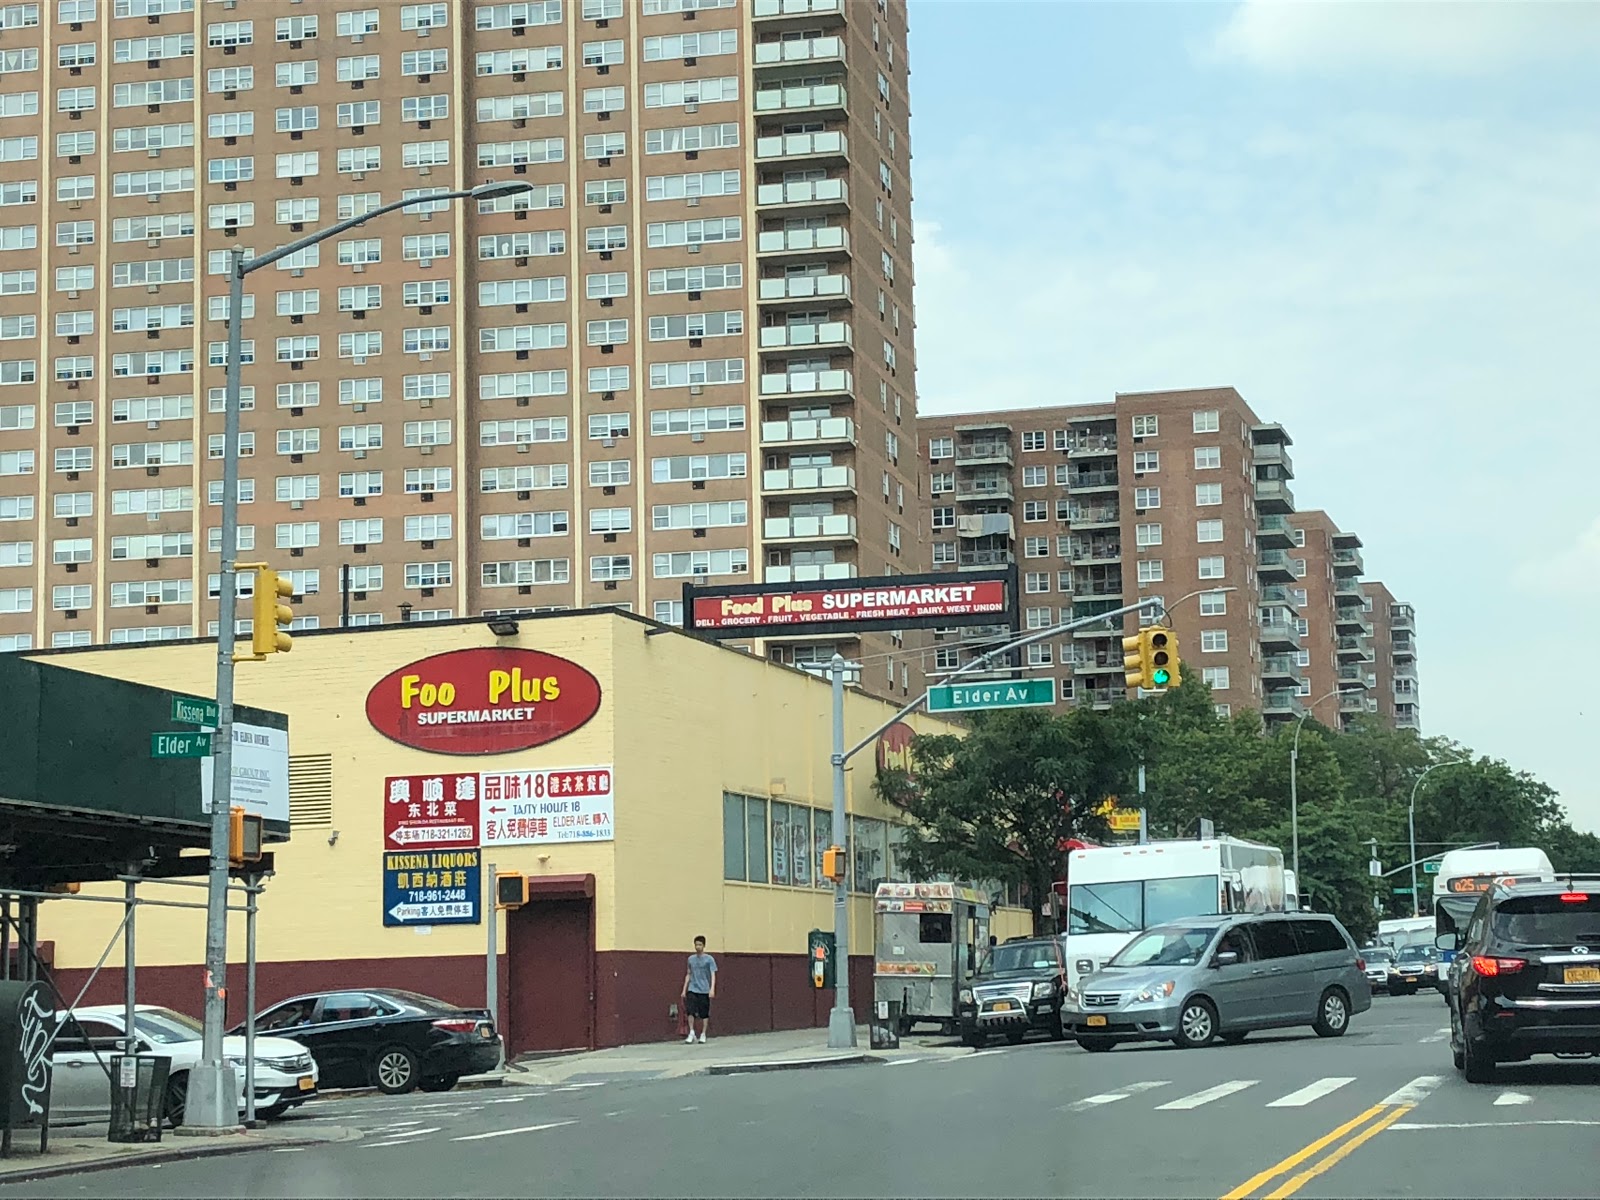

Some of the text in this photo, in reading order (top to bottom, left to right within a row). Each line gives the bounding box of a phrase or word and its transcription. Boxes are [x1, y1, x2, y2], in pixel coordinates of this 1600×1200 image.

[721, 586, 976, 616] Food Plus SUPERMARKET
[695, 619, 715, 627] DELI
[721, 616, 761, 625] GROCERY
[767, 614, 793, 623] FRUIT
[800, 612, 849, 621] VEGETABLE
[856, 609, 884, 618] FRESH
[886, 608, 910, 616] MEAT
[946, 605, 971, 613] WEST
[973, 603, 1002, 611] UNION
[401, 667, 560, 709] Foo Plus
[953, 687, 1028, 705] Elder Av
[176, 701, 204, 722] Kissena
[417, 707, 535, 725] SUPERMARKET
[158, 736, 206, 754] Elder Av
[485, 774, 544, 800] 品味18
[408, 801, 457, 818] 东北菜
[513, 801, 580, 815] TASTY HOUSE 18
[487, 817, 548, 840] 客人免費停車
[553, 815, 575, 827] ELDER
[421, 828, 471, 840] 718-321-1262
[387, 852, 478, 870] KISSENA LIQUORS
[409, 889, 466, 902] 718-961-2448
